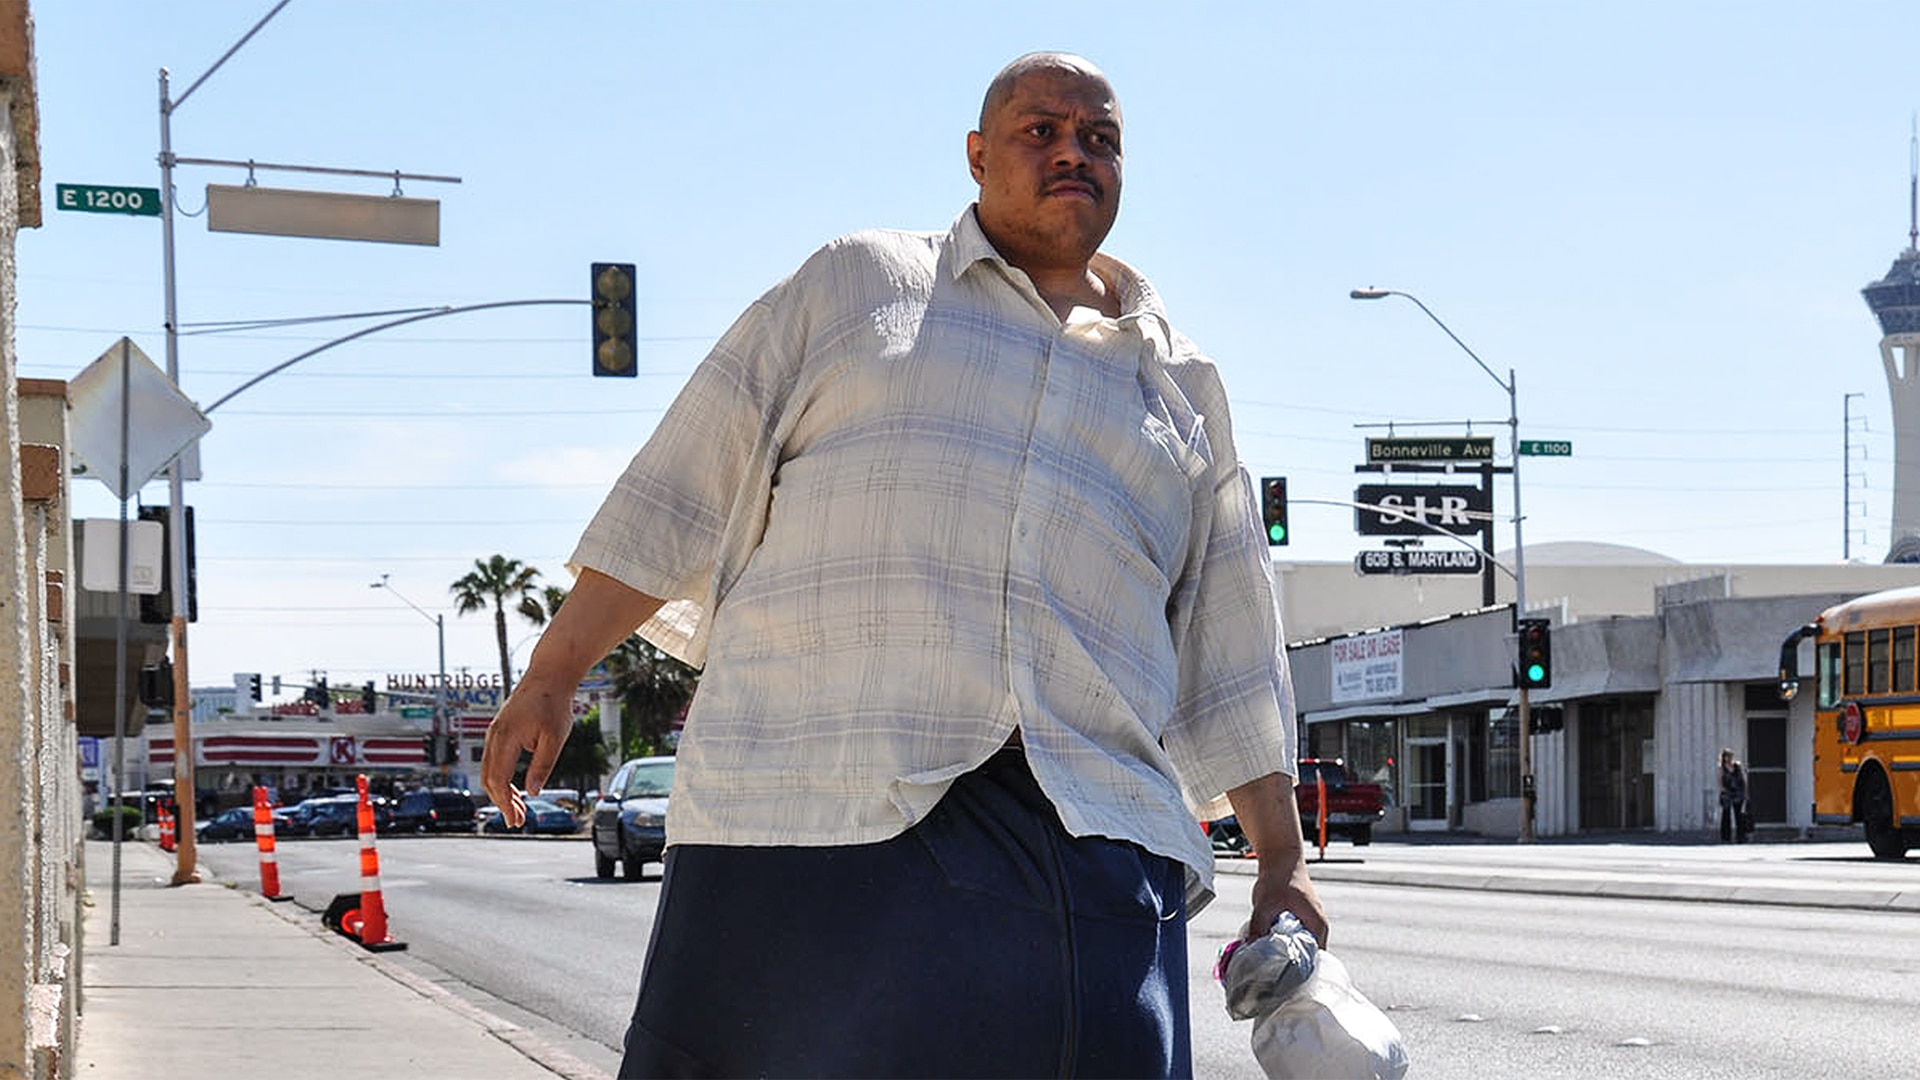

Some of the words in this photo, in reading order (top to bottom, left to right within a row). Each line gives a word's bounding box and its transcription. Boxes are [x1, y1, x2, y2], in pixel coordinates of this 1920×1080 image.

[63, 189, 77, 206] E
[86, 190, 142, 209] 1200
[1372, 444, 1452, 457] Bonneville
[1463, 443, 1491, 456] Ave
[1532, 442, 1540, 453] E
[1544, 443, 1569, 454] 1100
[1365, 552, 1389, 567] 608
[1408, 552, 1476, 567] MARYLAND
[387, 674, 500, 690] HUNTRIDGE
[333, 738, 355, 764] K
